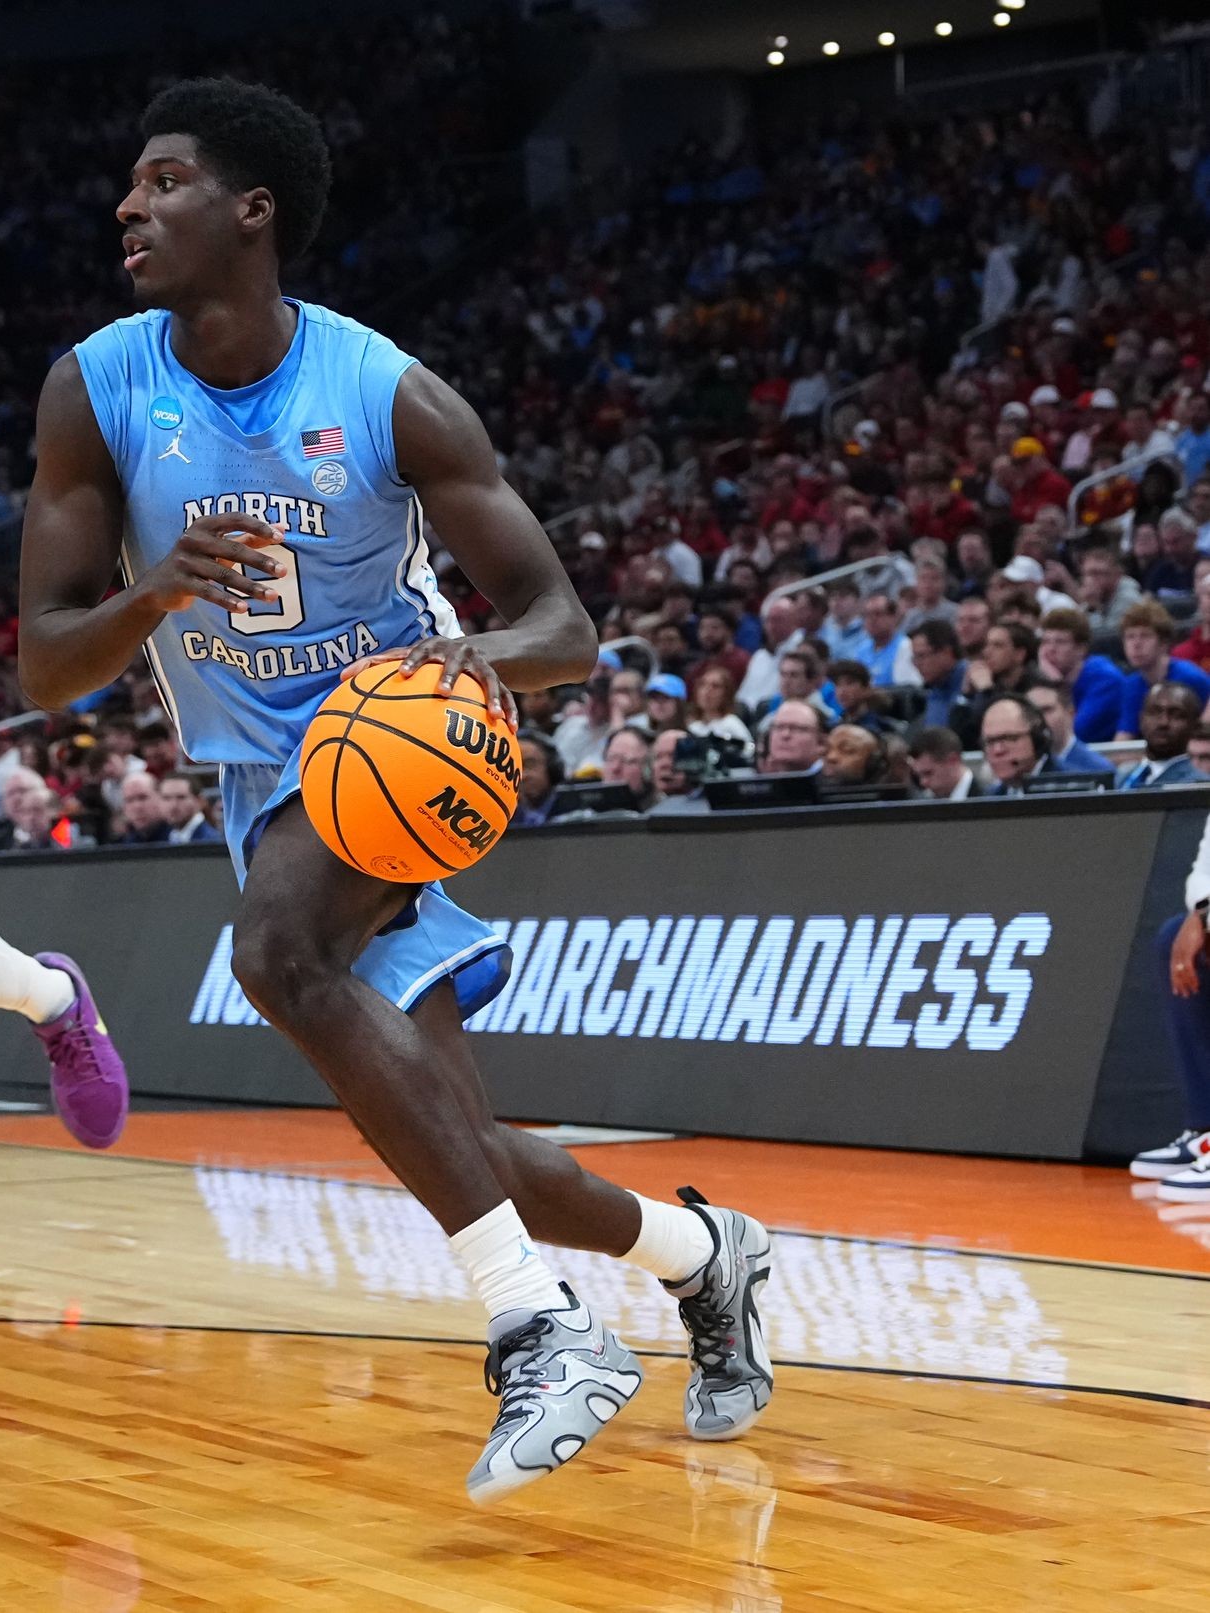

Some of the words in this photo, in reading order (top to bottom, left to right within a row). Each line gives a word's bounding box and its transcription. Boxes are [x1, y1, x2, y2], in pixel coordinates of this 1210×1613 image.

[153, 409, 180, 423] NCAA
[318, 472, 343, 482] ACC
[184, 491, 328, 538] NORTH
[182, 621, 380, 681] CAROLINA
[445, 707, 522, 794] Wilso
[485, 767, 500, 781] EVO
[500, 779, 511, 792] NXT
[416, 806, 448, 838] OFFICIAL
[424, 785, 499, 855] NCAA
